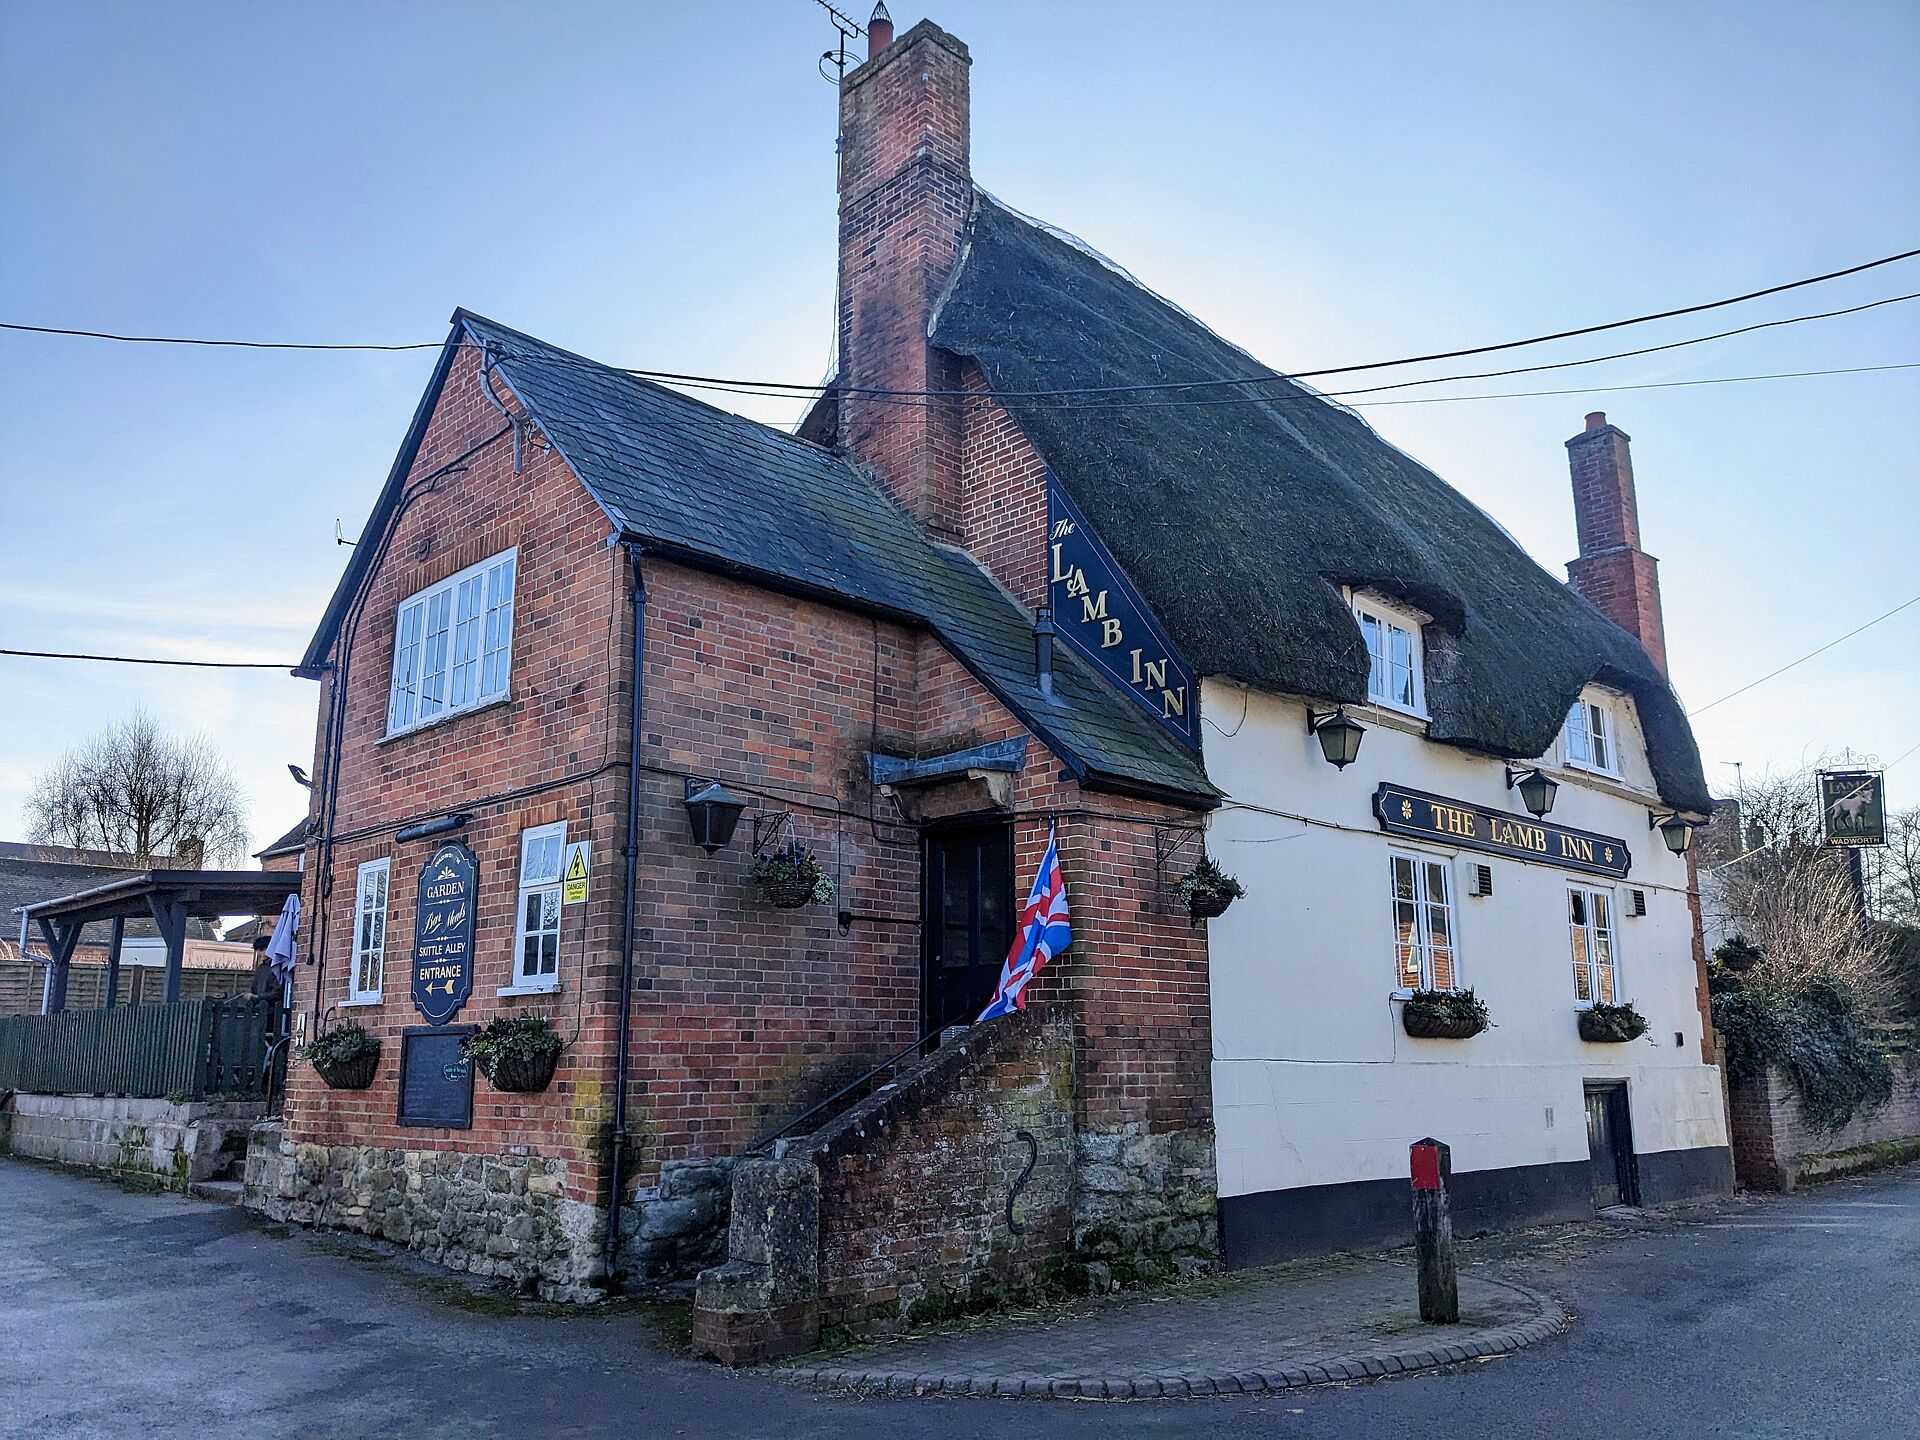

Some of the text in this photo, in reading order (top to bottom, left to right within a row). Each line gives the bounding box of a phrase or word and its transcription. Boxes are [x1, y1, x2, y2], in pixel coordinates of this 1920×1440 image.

[1049, 518, 1185, 719] The LAMB INN
[1431, 804, 1594, 862] THE LAMB INN
[427, 881, 465, 899] GARDEN
[566, 881, 586, 891] DANGER
[421, 902, 466, 935] Bar Meals
[419, 942, 466, 957] SKITTLE ALLEY
[420, 965, 461, 980] ENTRANCE
